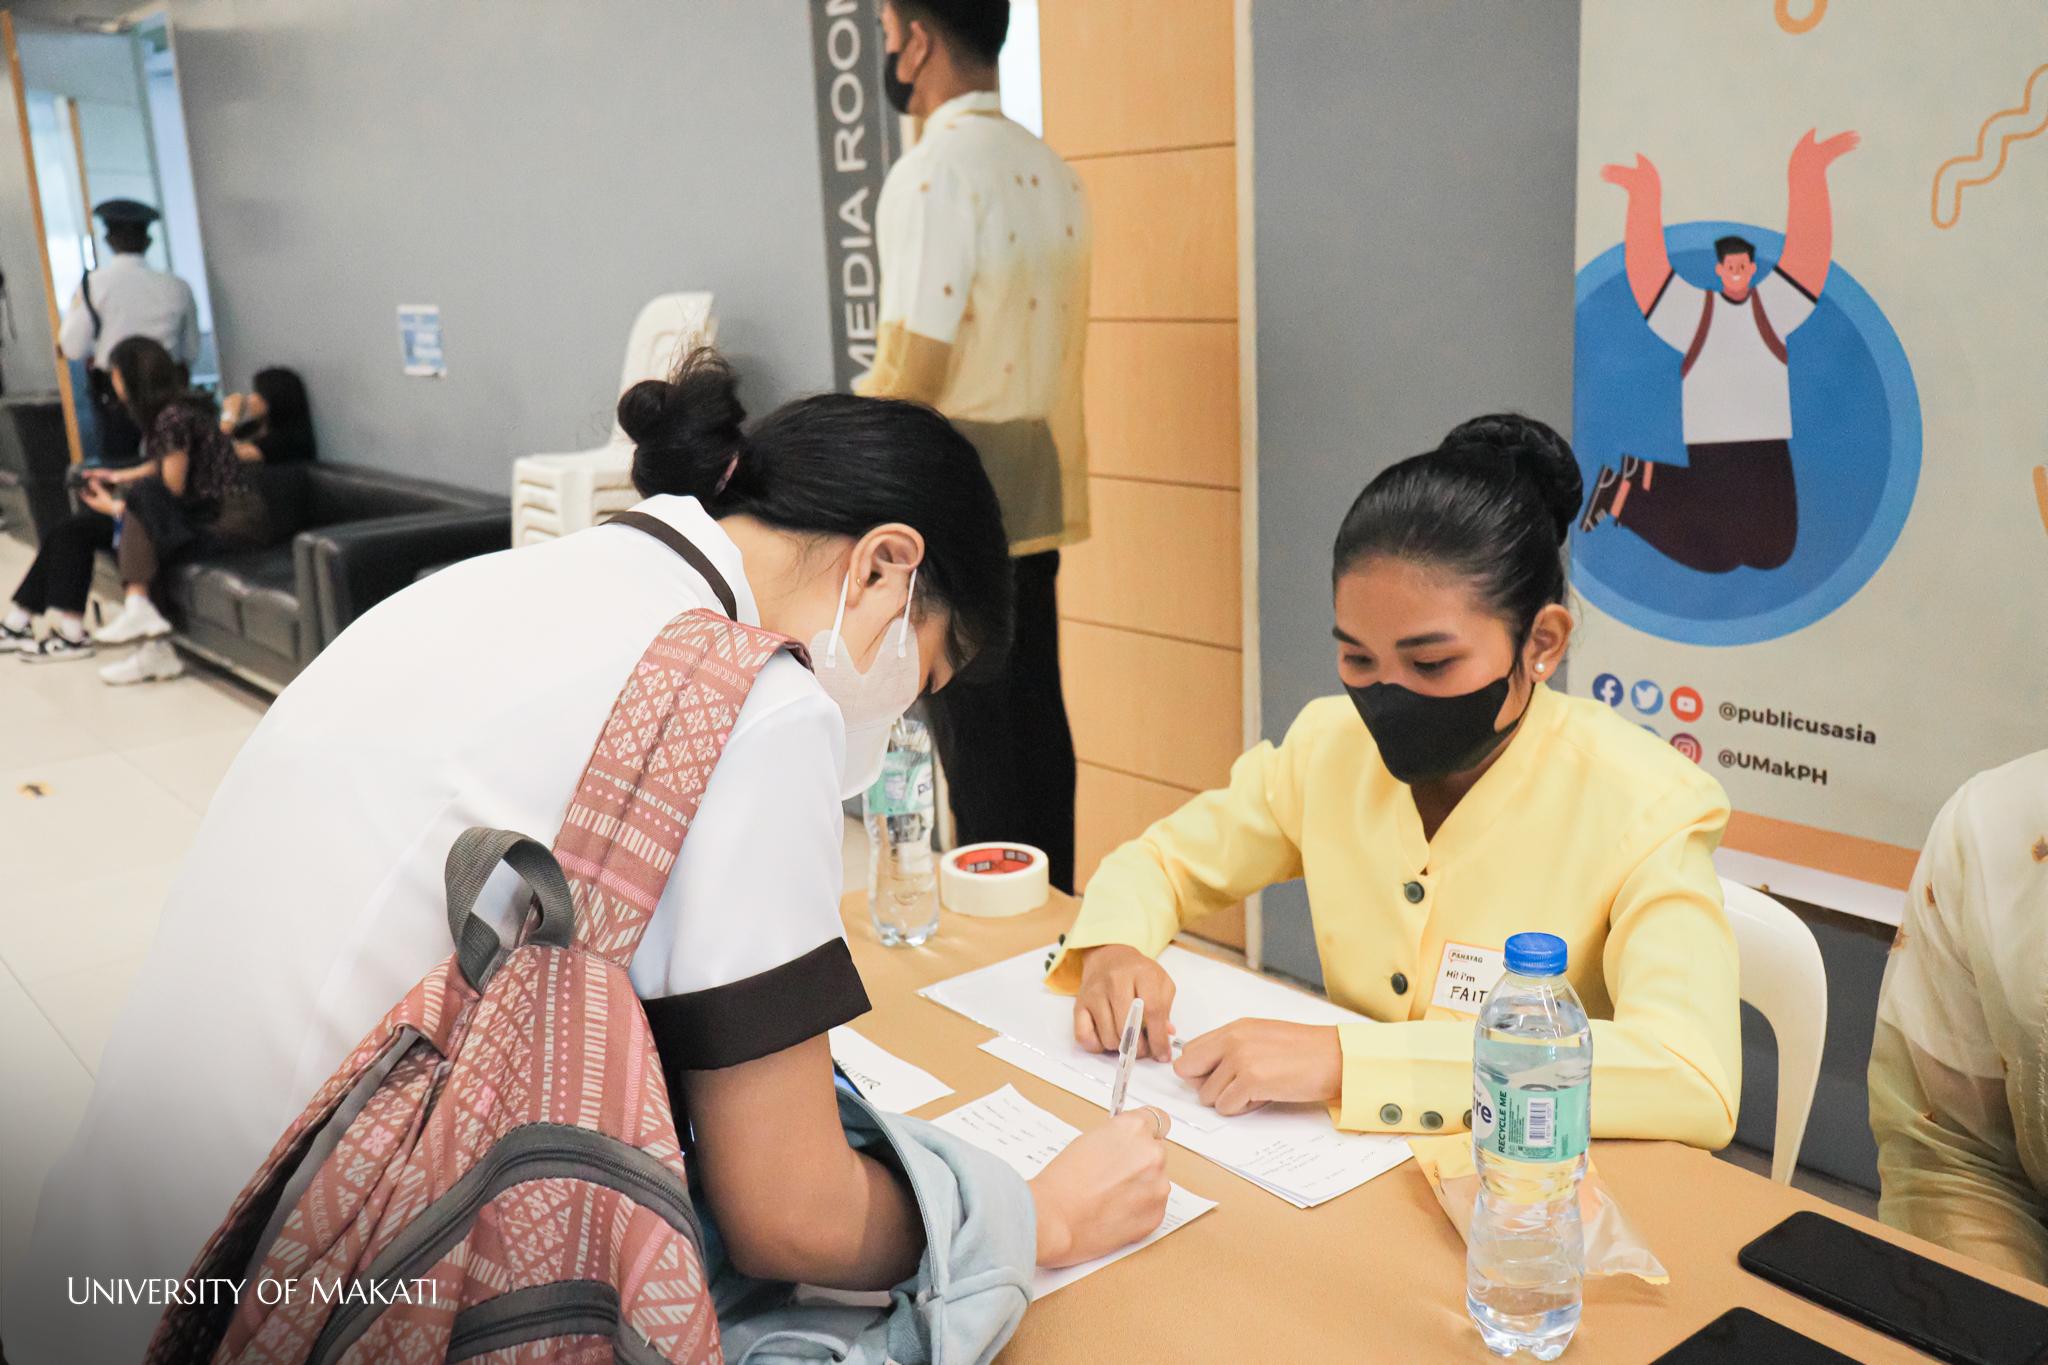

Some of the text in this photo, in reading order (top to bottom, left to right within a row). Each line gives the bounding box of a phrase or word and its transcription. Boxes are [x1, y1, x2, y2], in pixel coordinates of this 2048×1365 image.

[1718, 701, 1877, 745] @publicusasia
[1717, 748, 1828, 786] @UMakPH
[1450, 985, 1488, 1003] FAIT
[1498, 1090, 1507, 1153] RECYCLE ME
